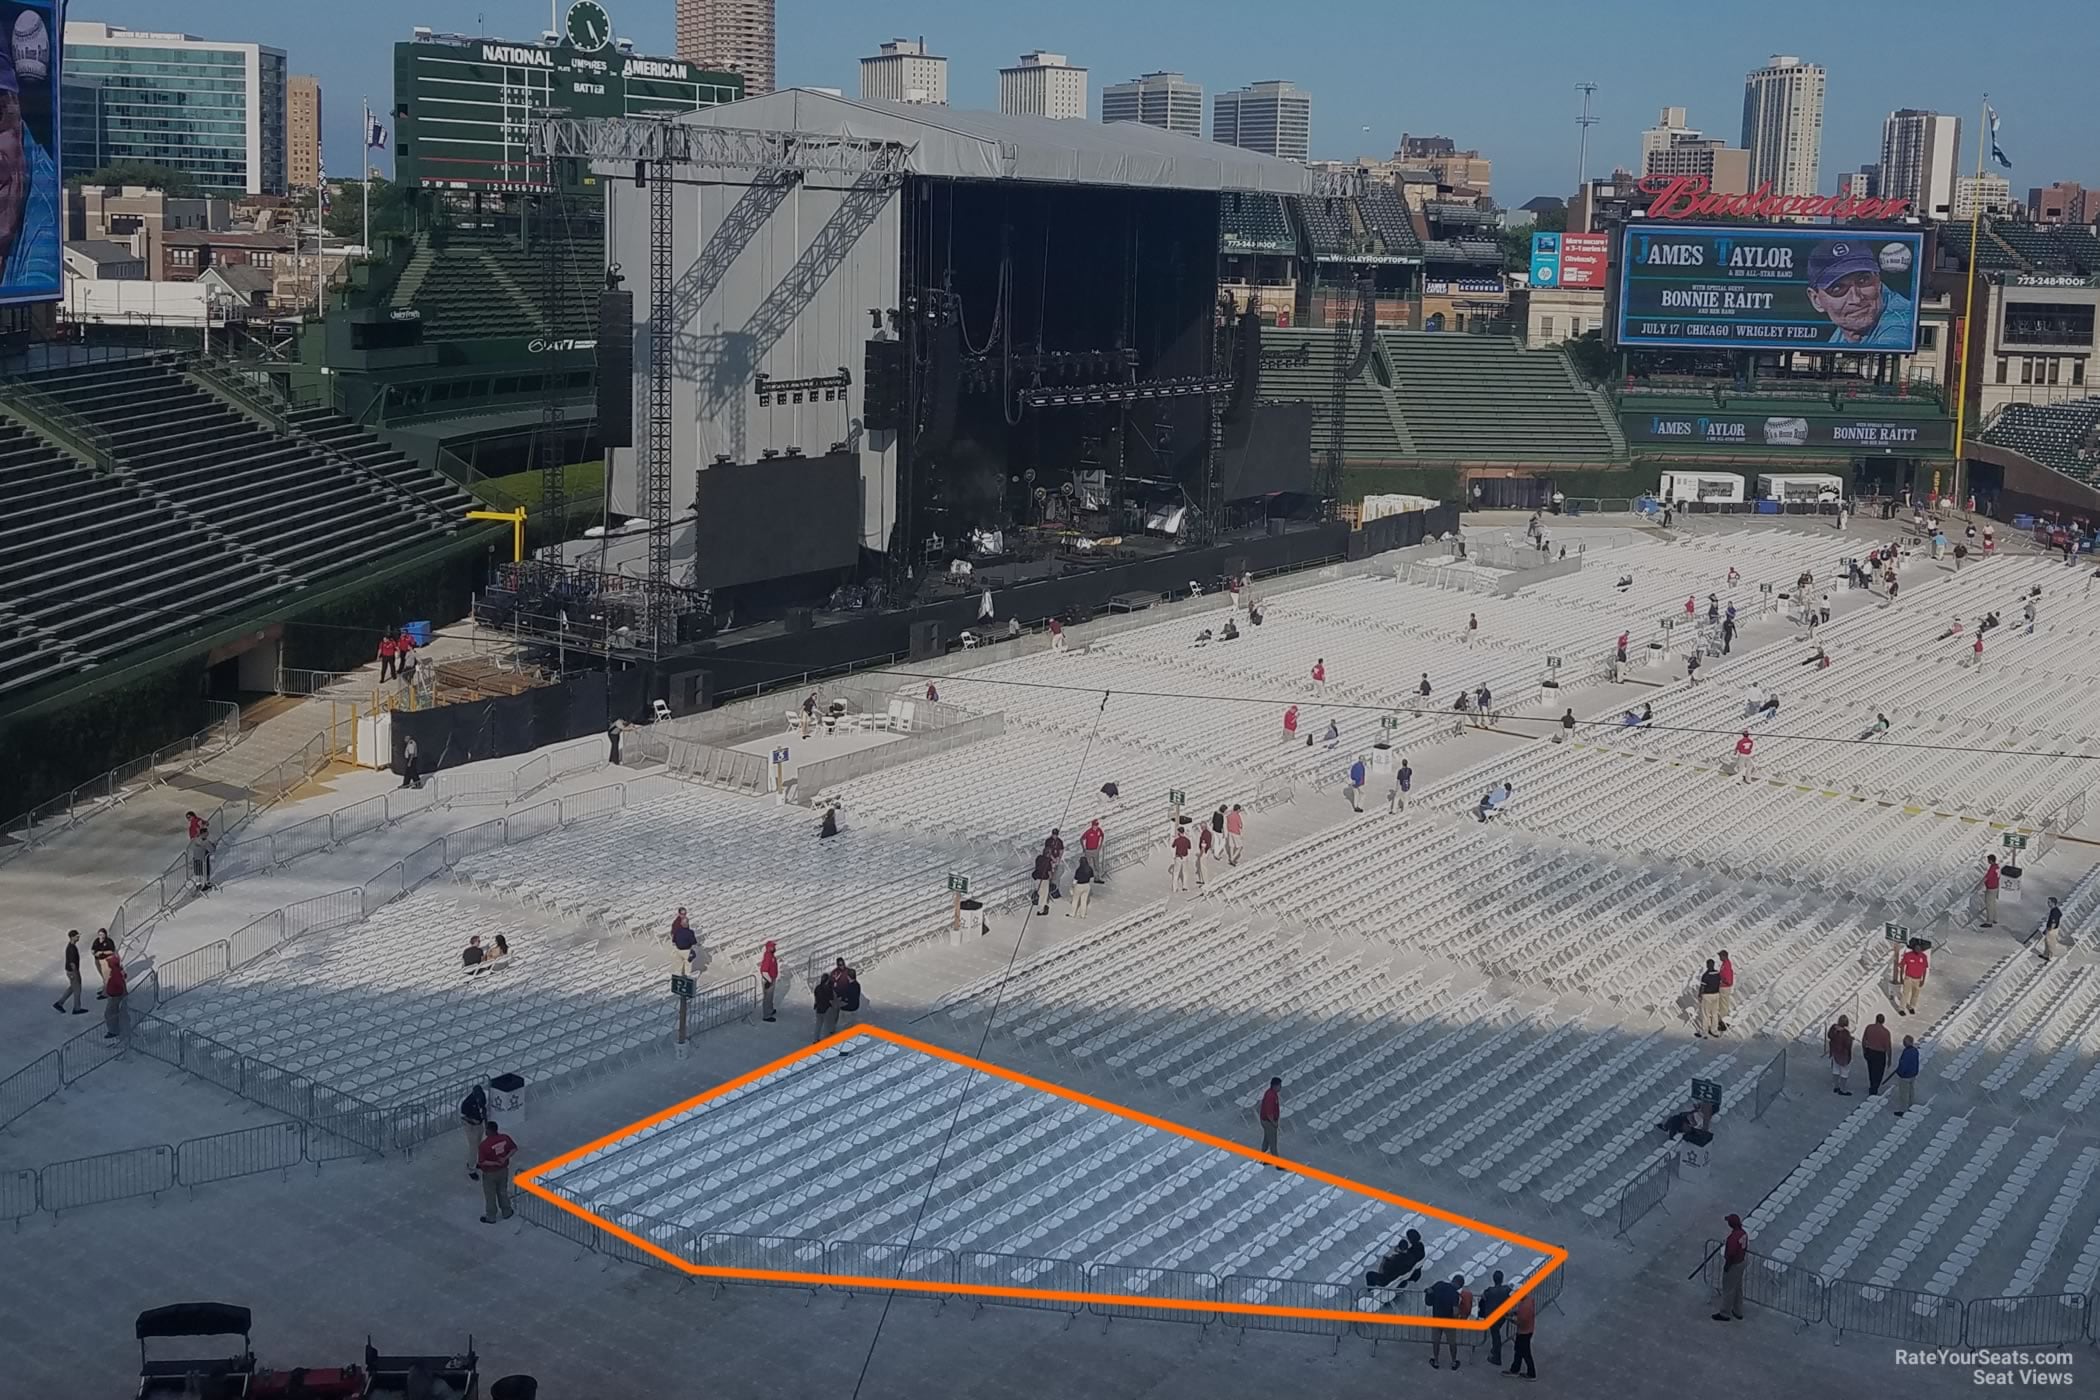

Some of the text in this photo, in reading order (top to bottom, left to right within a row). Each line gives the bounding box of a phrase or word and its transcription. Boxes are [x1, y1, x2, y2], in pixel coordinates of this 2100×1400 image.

[483, 45, 554, 67] NATIONAL
[571, 58, 607, 71] UMPIRES
[624, 59, 687, 80] AMERICAN
[574, 82, 604, 94] BATTER
[1638, 174, 1910, 219] Budweiser
[1635, 235, 1794, 269] JAMES TAYLOR
[1661, 290, 1773, 309] BONNIE RAITT
[1641, 323, 1680, 335] JULY 17
[1687, 324, 1729, 336] CHICAGO
[1736, 325, 1818, 338] WRIGLEY FIELD
[1653, 416, 1746, 437] JAMES TAYLOR
[1833, 427, 1917, 441] BONNIE RAITT
